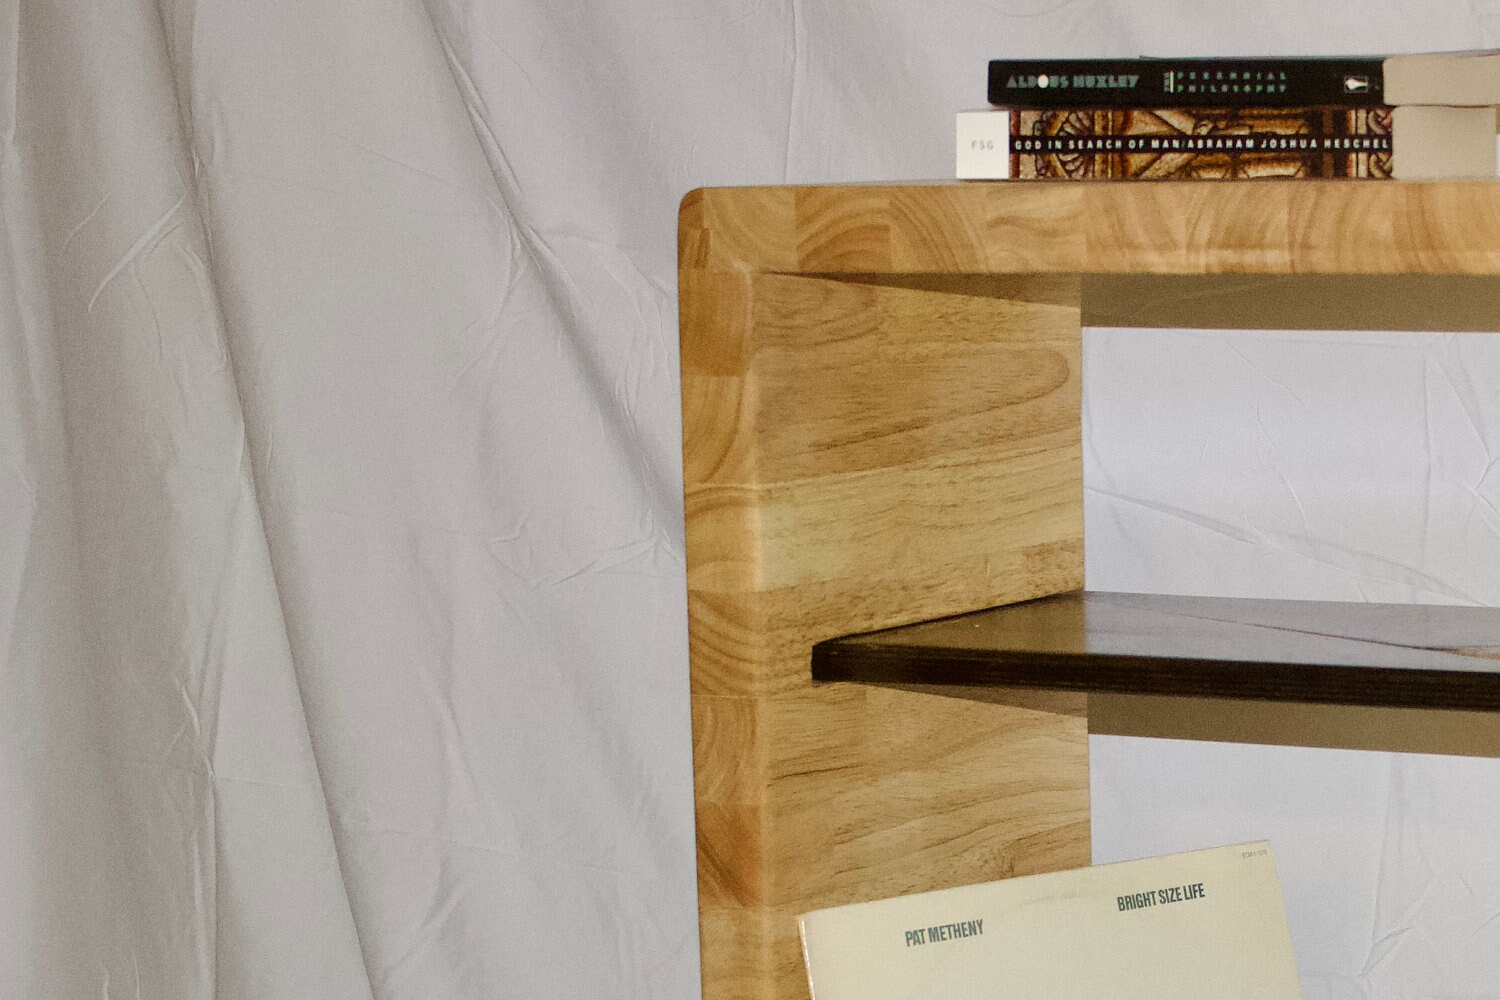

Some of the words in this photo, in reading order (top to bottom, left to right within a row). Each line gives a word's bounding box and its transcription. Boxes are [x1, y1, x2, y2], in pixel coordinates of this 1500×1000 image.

[1006, 74, 1068, 89] ALDOUS
[1072, 74, 1140, 89] HUXLEY
[1177, 71, 1286, 80] PERENNIAL
[1177, 84, 1286, 93] PHILOSOPHY
[971, 140, 994, 150] FSG
[1015, 140, 1041, 150] GOD
[1047, 140, 1062, 150] IN
[1068, 140, 1122, 150] SEARCH
[1128, 140, 1145, 149] OF
[1260, 139, 1318, 149] JOSHUA
[1324, 138, 1389, 149] HESCHEL
[1116, 890, 1157, 912] BRIGHT
[1158, 886, 1183, 904] SIZE
[1183, 882, 1206, 900] LIFE
[904, 928, 926, 947] PAT
[927, 918, 984, 943] METHENY
